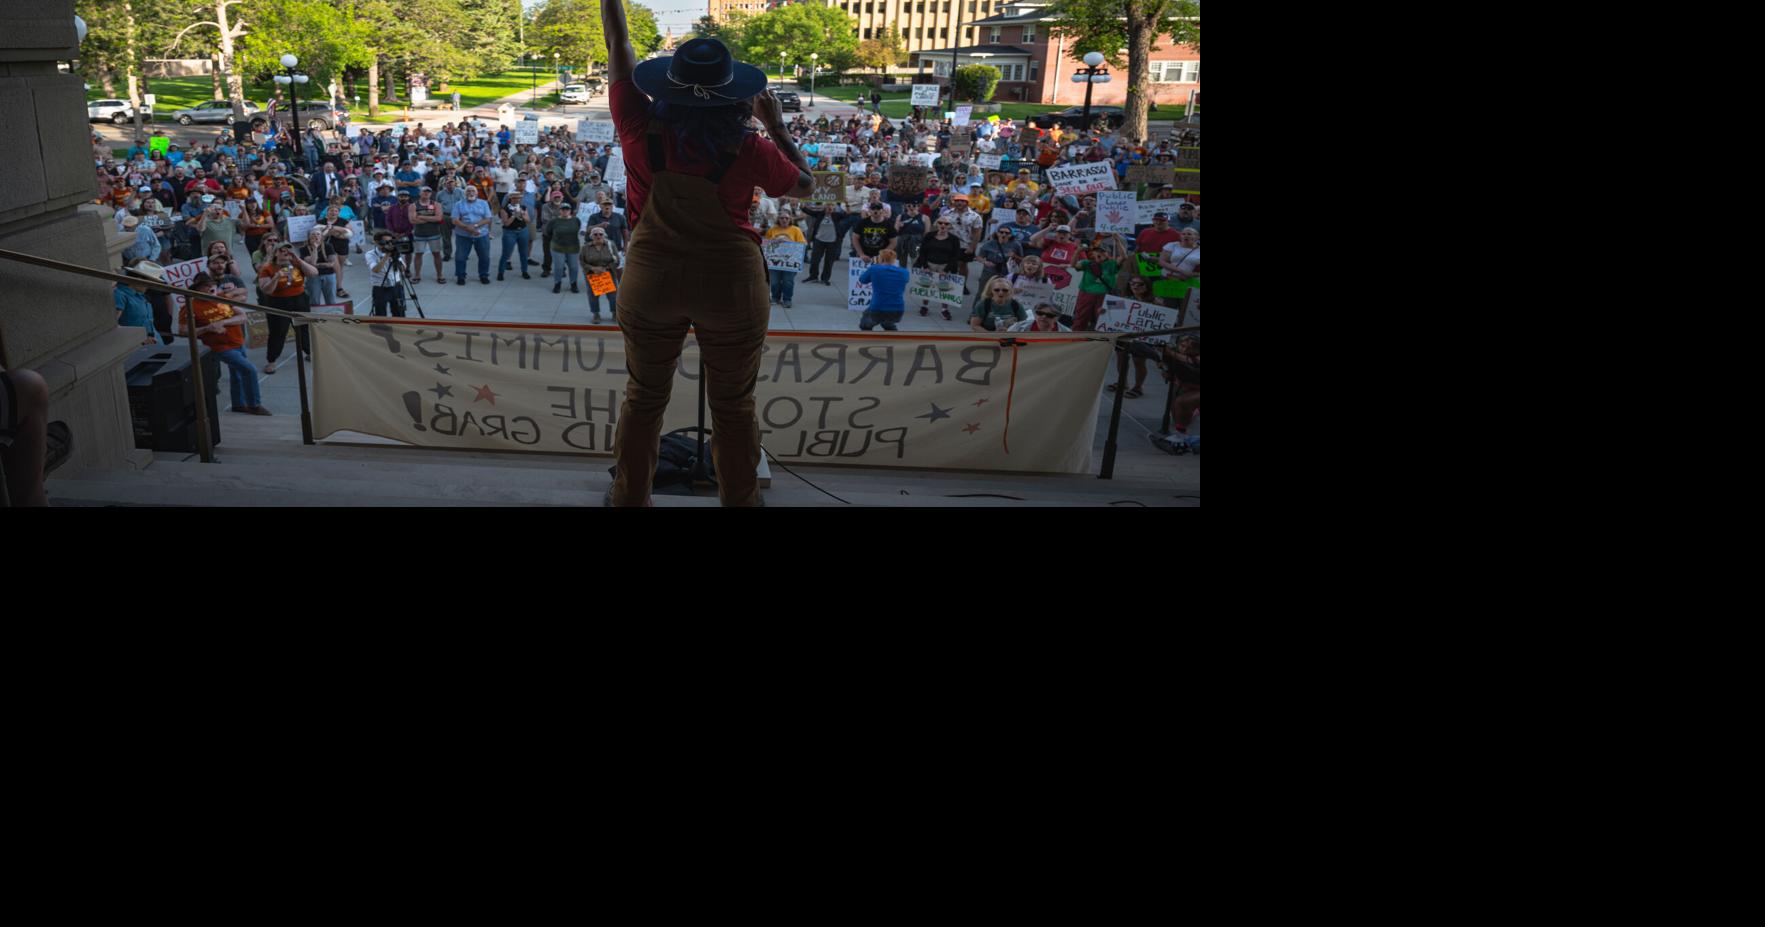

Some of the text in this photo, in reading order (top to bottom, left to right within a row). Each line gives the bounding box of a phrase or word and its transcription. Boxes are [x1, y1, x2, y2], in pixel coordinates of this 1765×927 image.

[1050, 165, 1107, 181] BARRASSO
[811, 192, 837, 201] LAND
[166, 260, 203, 281] NOT
[172, 278, 194, 289] FO
[1126, 314, 1171, 331] Lands
